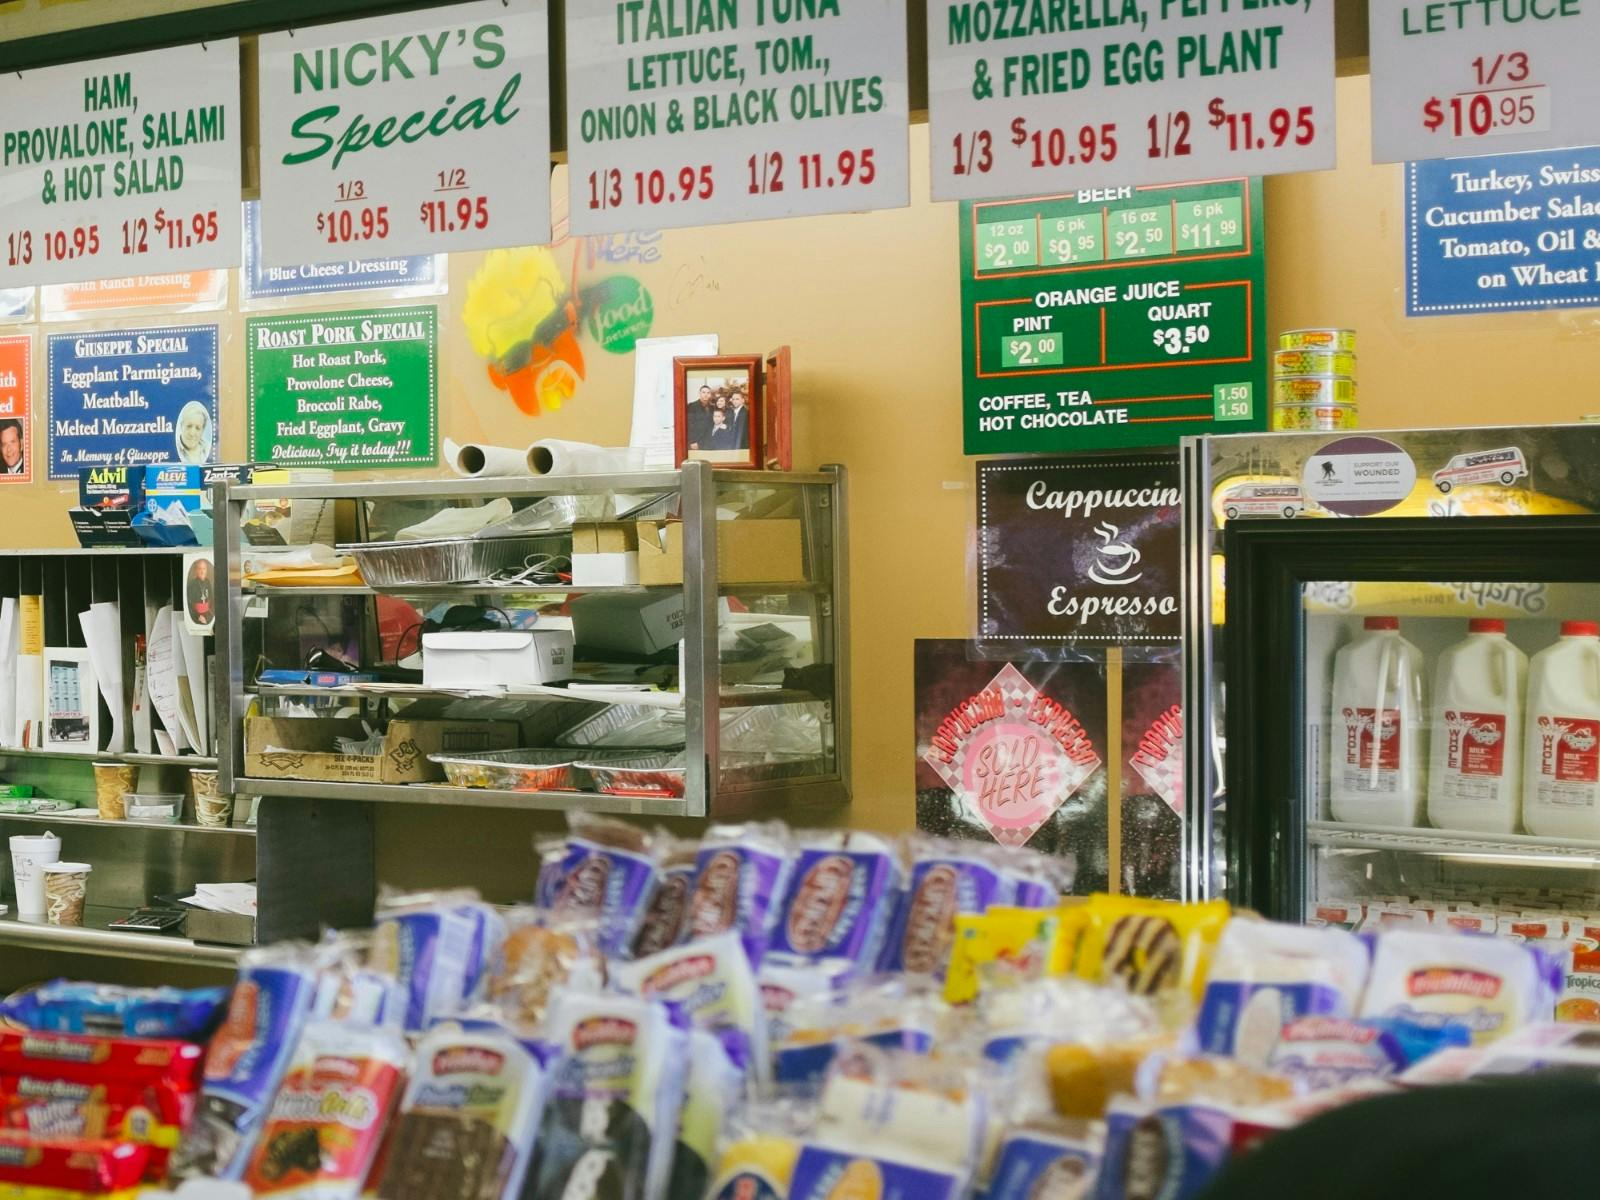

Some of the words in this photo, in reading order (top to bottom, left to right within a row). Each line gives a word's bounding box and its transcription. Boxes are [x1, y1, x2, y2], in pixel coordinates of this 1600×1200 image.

[293, 23, 506, 94] NICKY'S
[628, 44, 745, 92] LETTUCE,
[756, 35, 830, 76] TOM.,
[972, 58, 992, 100] &
[1004, 48, 1091, 97] FRIED
[1104, 40, 1164, 86] EGG
[1178, 26, 1283, 78] PLANT
[1472, 52, 1529, 85] 1/3
[84, 72, 138, 114] HAM,
[281, 73, 522, 169] Special
[581, 102, 656, 143] ONION
[666, 99, 684, 133] &
[694, 88, 779, 130] BLACK
[791, 76, 883, 120] OLIVES
[1424, 94, 1535, 137] $10.95
[4, 119, 134, 166] PROVALONE,
[143, 106, 225, 149] SALAMI
[1011, 116, 1118, 167] $10.95
[1208, 97, 1315, 152] $11.95
[42, 169, 56, 203] &
[64, 164, 105, 202] HOT
[114, 155, 184, 197] SALAD
[1451, 169, 1533, 194] Turkey,
[316, 206, 390, 244] $10.95
[420, 196, 489, 233] $11.95
[1425, 202, 1541, 227] Cucumber
[7, 230, 33, 266] 1/3
[44, 225, 100, 262] 10.95
[121, 217, 148, 255] 1/2
[154, 208, 218, 249] $11.95
[1440, 237, 1530, 258] Tomato,
[1537, 230, 1574, 252] Oil
[270, 266, 296, 281] Blue
[299, 264, 345, 279] Cheese
[1477, 272, 1506, 288] on
[1512, 265, 1588, 286] Wheat
[1035, 287, 1117, 308] ORANGE
[1123, 281, 1180, 300] JUICE
[1013, 315, 1052, 332] PINT
[1148, 303, 1211, 321] QUART
[75, 338, 133, 358] GIUSEPPE
[137, 336, 188, 354] SPECIAL
[257, 326, 306, 348] ROAST
[312, 323, 355, 345] PORK
[361, 319, 424, 342] SPECIAL
[1010, 339, 1055, 365] $2.00
[1153, 325, 1209, 354] $3.50
[83, 392, 149, 410] Meatballs,
[297, 397, 345, 413] Broccoli
[349, 396, 382, 412] Rabe,
[979, 393, 1051, 411] COFFEE,
[1057, 391, 1092, 407] TEA
[1218, 387, 1248, 401] 1.50
[56, 421, 99, 436] Melted
[102, 419, 173, 434] Mozzarella
[277, 422, 306, 436] Fried
[309, 422, 365, 440] Eggplant,
[369, 419, 405, 435] Gravy
[979, 416, 1016, 432] HOT
[1021, 409, 1128, 429] CHOCOLATE
[1218, 403, 1248, 417] 1.50
[90, 467, 127, 484] Advil
[157, 471, 187, 482] ALEVE
[1354, 469, 1400, 477] WOUNDED
[1026, 480, 1182, 518] Cappuccin
[1047, 586, 1178, 624] Espresso
[975, 734, 1041, 778] SOLD
[979, 768, 1047, 809] HERE
